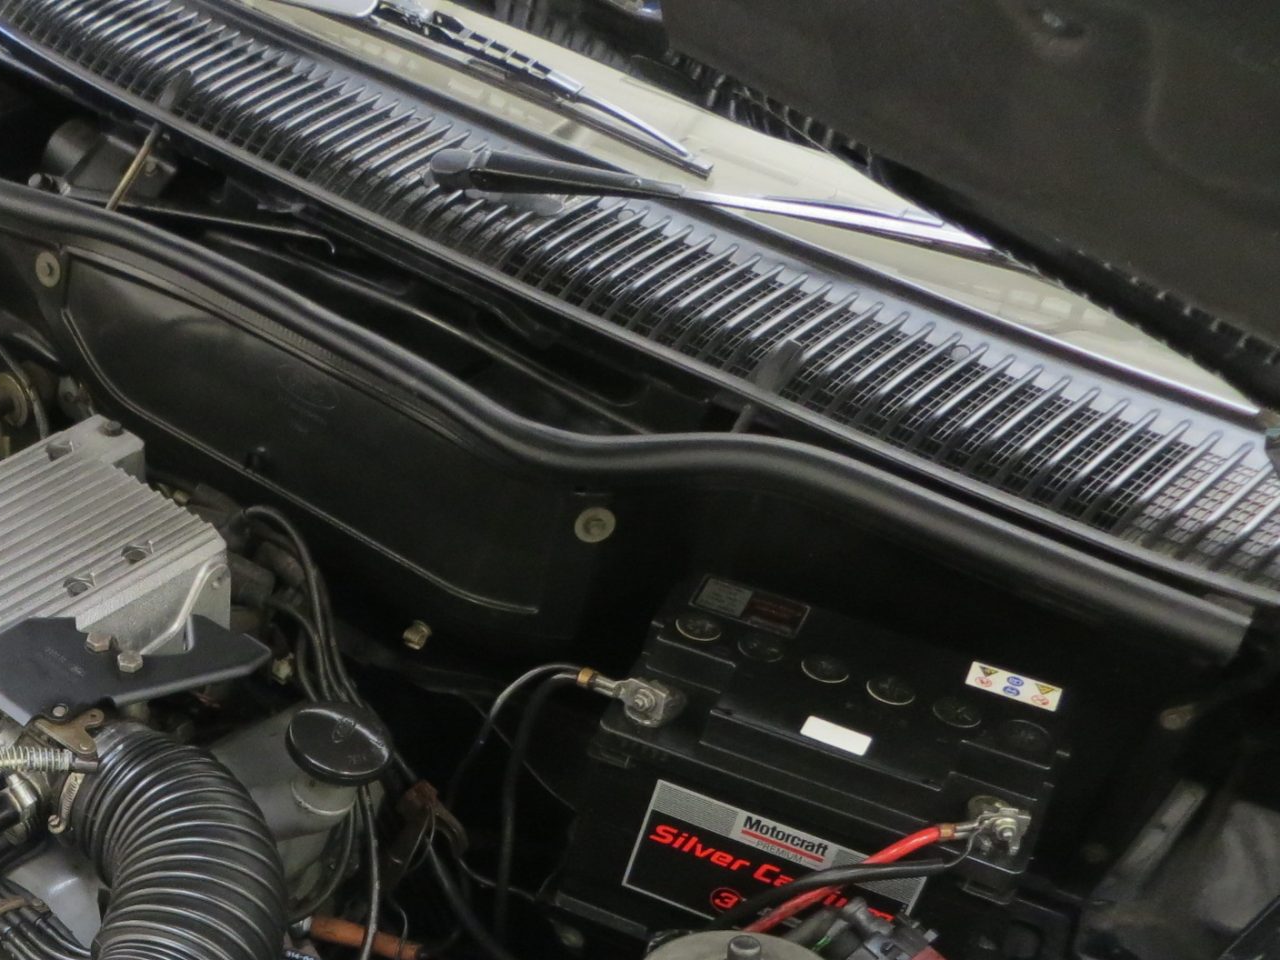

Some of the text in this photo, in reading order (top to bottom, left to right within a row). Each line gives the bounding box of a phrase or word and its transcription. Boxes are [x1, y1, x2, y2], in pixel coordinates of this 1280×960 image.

[649, 824, 751, 871] Silver
[743, 815, 828, 857] Motorcraft
[755, 840, 803, 864] PREMIUM
